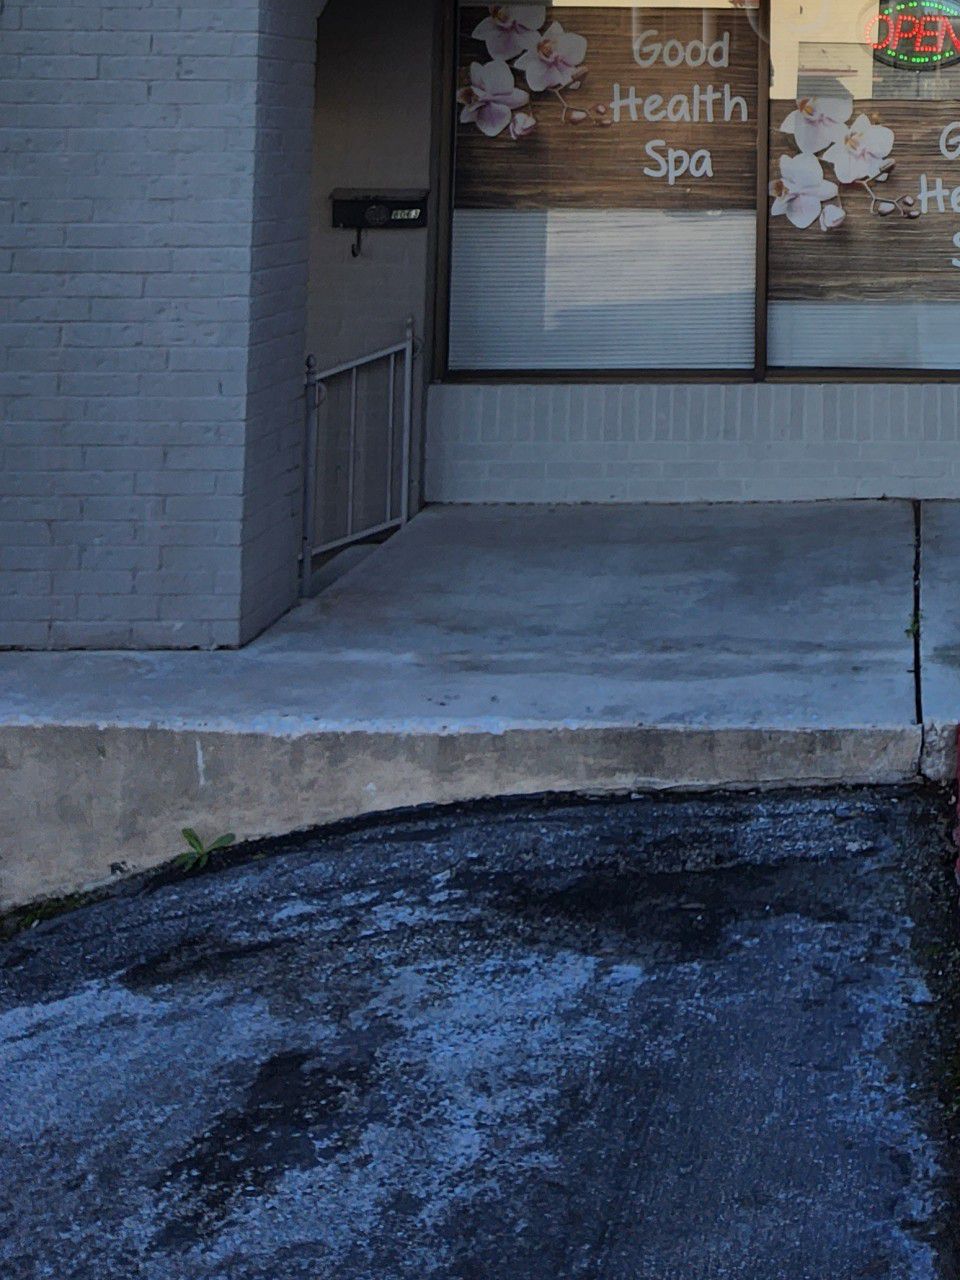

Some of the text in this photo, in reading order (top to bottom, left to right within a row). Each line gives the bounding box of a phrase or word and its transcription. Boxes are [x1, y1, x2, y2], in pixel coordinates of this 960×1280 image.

[633, 29, 730, 68] Good
[610, 83, 749, 124] Health
[642, 139, 715, 186] Spa
